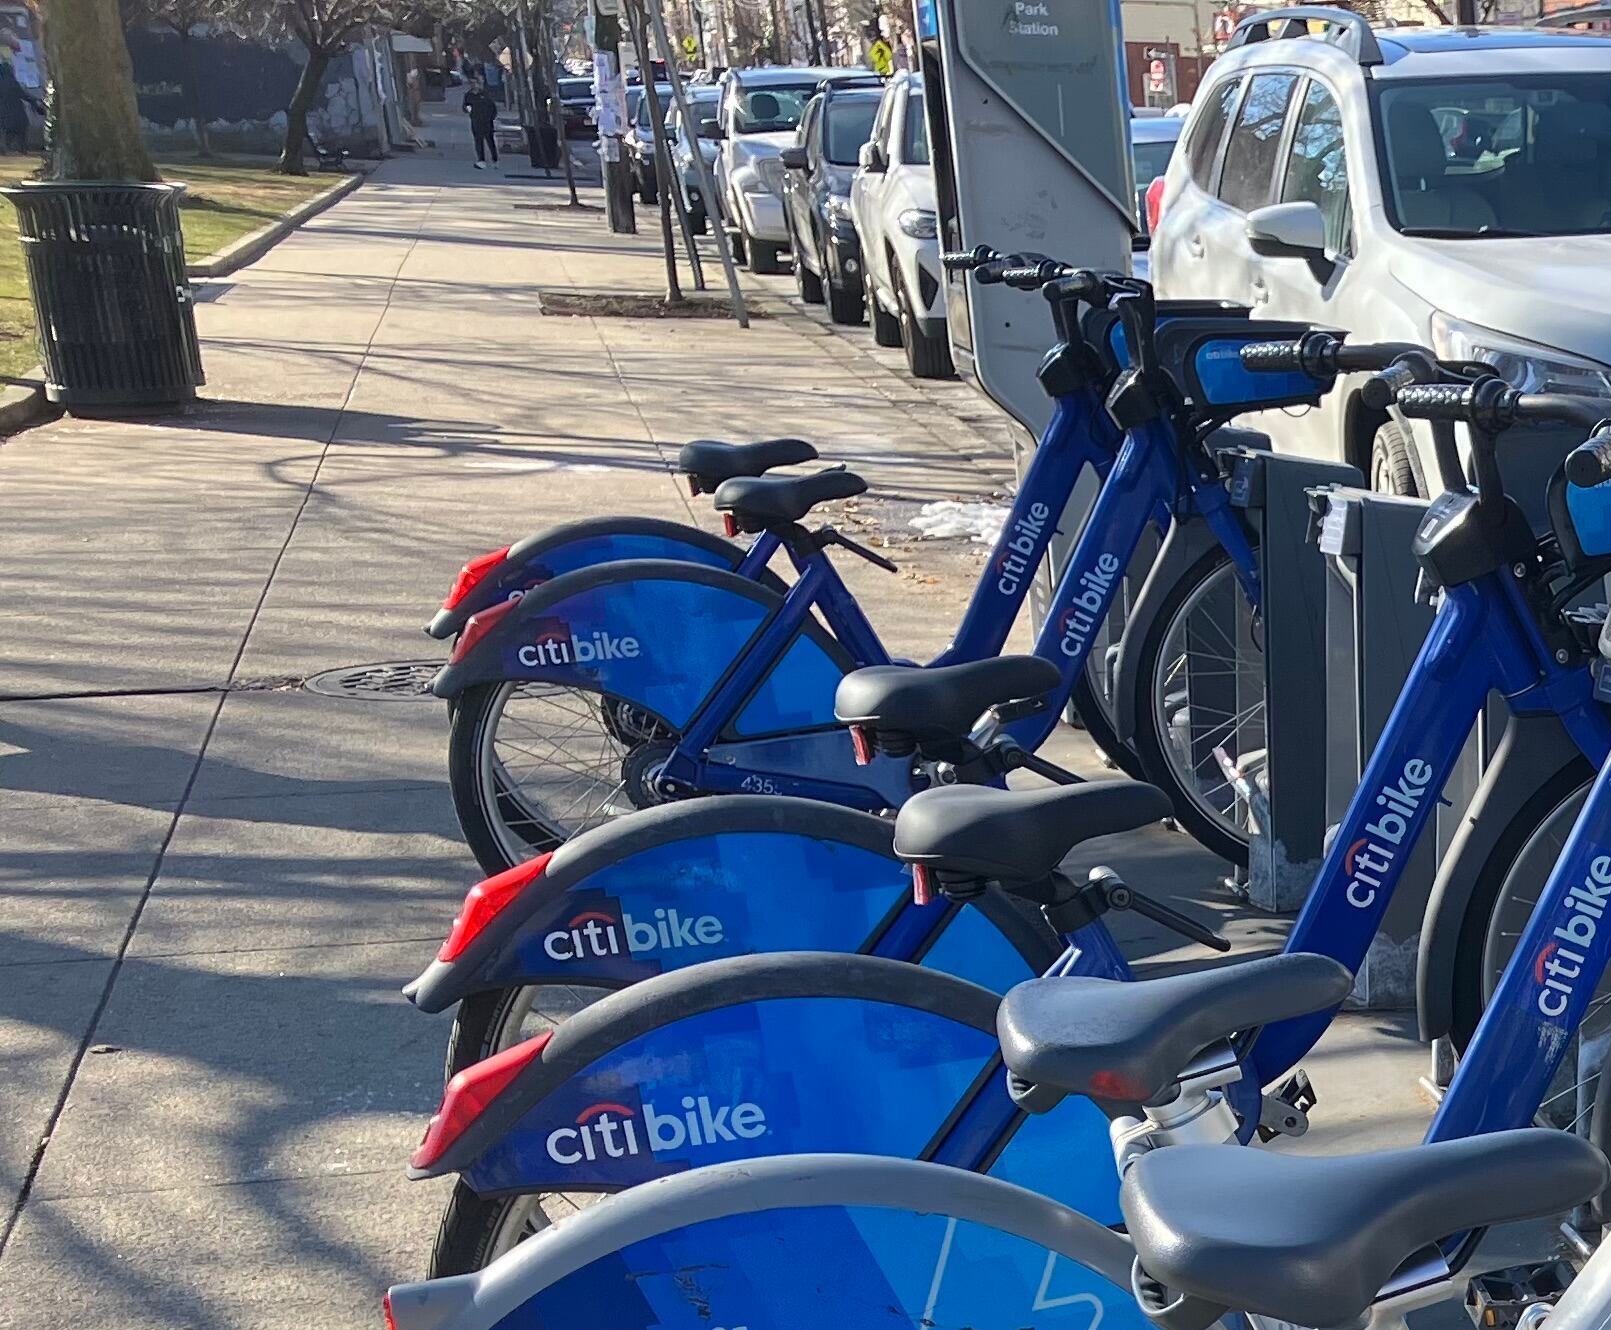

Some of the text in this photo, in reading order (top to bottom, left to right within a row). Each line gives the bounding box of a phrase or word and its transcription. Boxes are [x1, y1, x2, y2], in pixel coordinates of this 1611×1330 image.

[1009, 20, 1059, 36] Station
[1015, 1, 1049, 16] Park
[997, 502, 1050, 596] citi bike
[1060, 552, 1120, 658] citi bike
[518, 631, 641, 667] citi bike
[1345, 757, 1433, 910] citi bike
[544, 908, 725, 961] citi bike
[1534, 942, 1586, 1018] citi
[546, 1096, 768, 1165] citi bike
